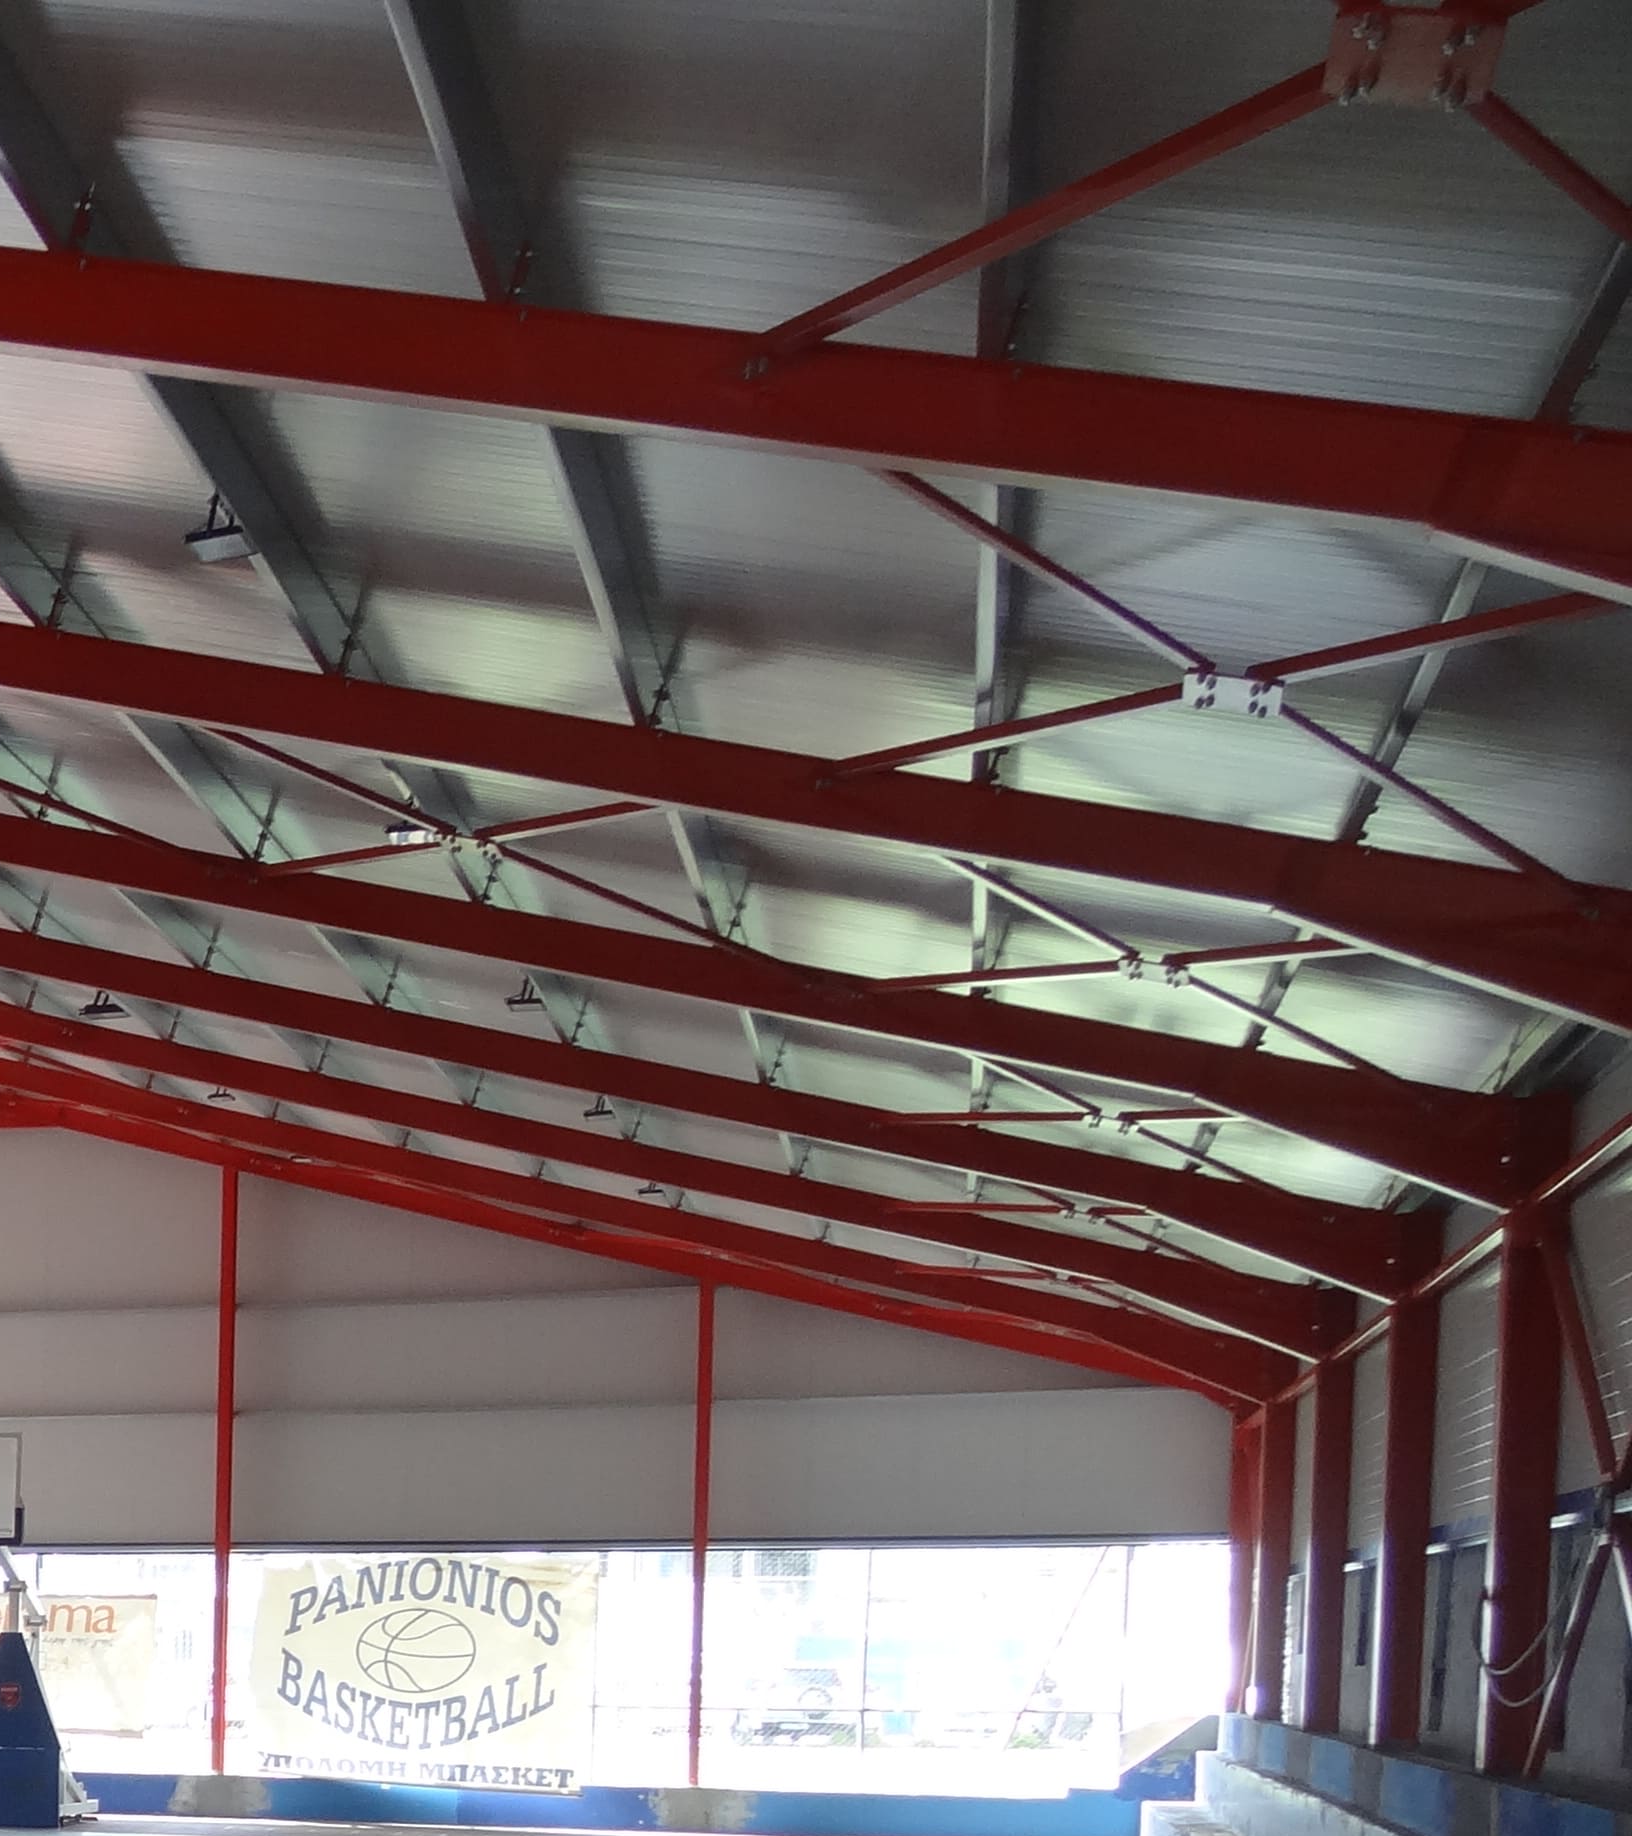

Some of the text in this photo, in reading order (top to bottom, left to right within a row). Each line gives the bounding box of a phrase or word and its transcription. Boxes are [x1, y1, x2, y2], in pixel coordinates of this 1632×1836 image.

[284, 1557, 562, 1647] PANIONIOS
[277, 1646, 556, 1751] BASKETBALL
[419, 1762, 574, 1788] ΜΠΑΣΚΕΤ
